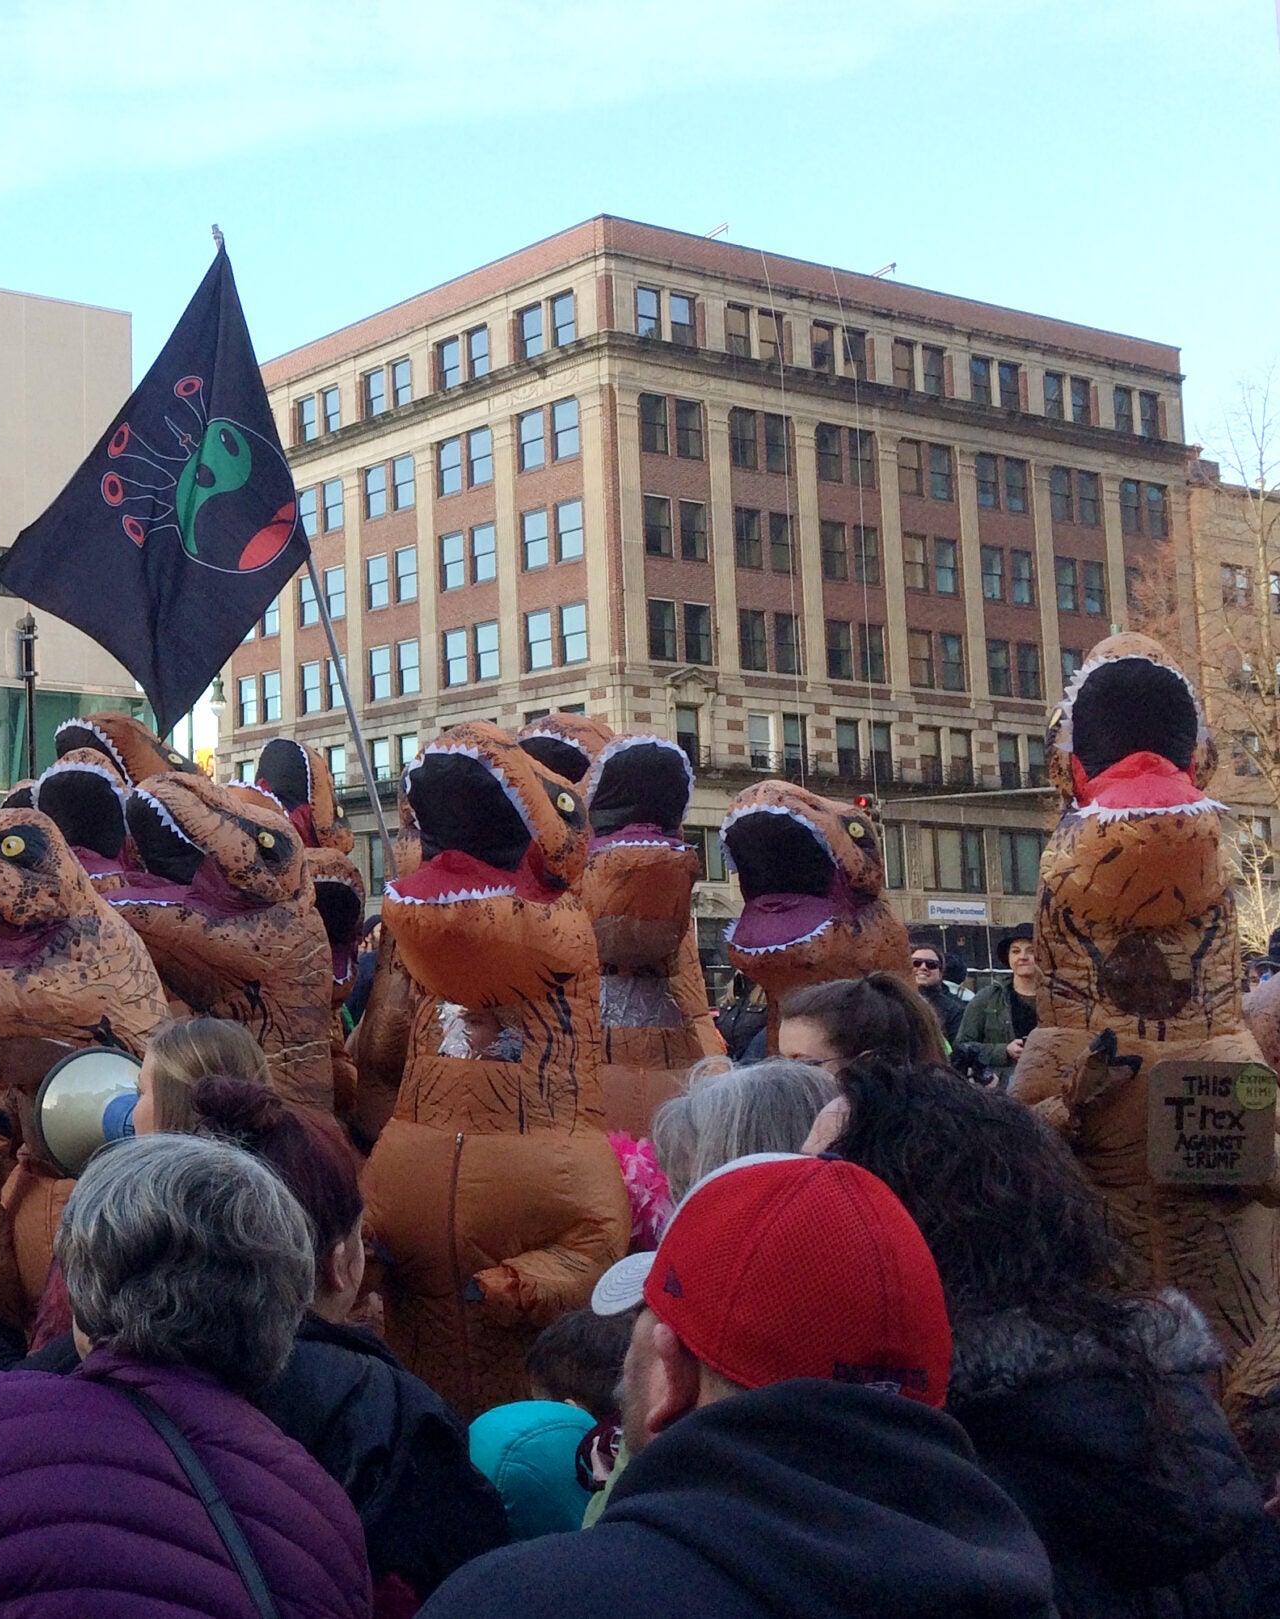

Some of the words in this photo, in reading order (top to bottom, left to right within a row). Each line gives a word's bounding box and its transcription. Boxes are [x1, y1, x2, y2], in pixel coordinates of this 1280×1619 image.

[1182, 1075, 1232, 1098] THIS
[1164, 1097, 1246, 1131] T-rex
[1174, 1132, 1246, 1152] AGAINST
